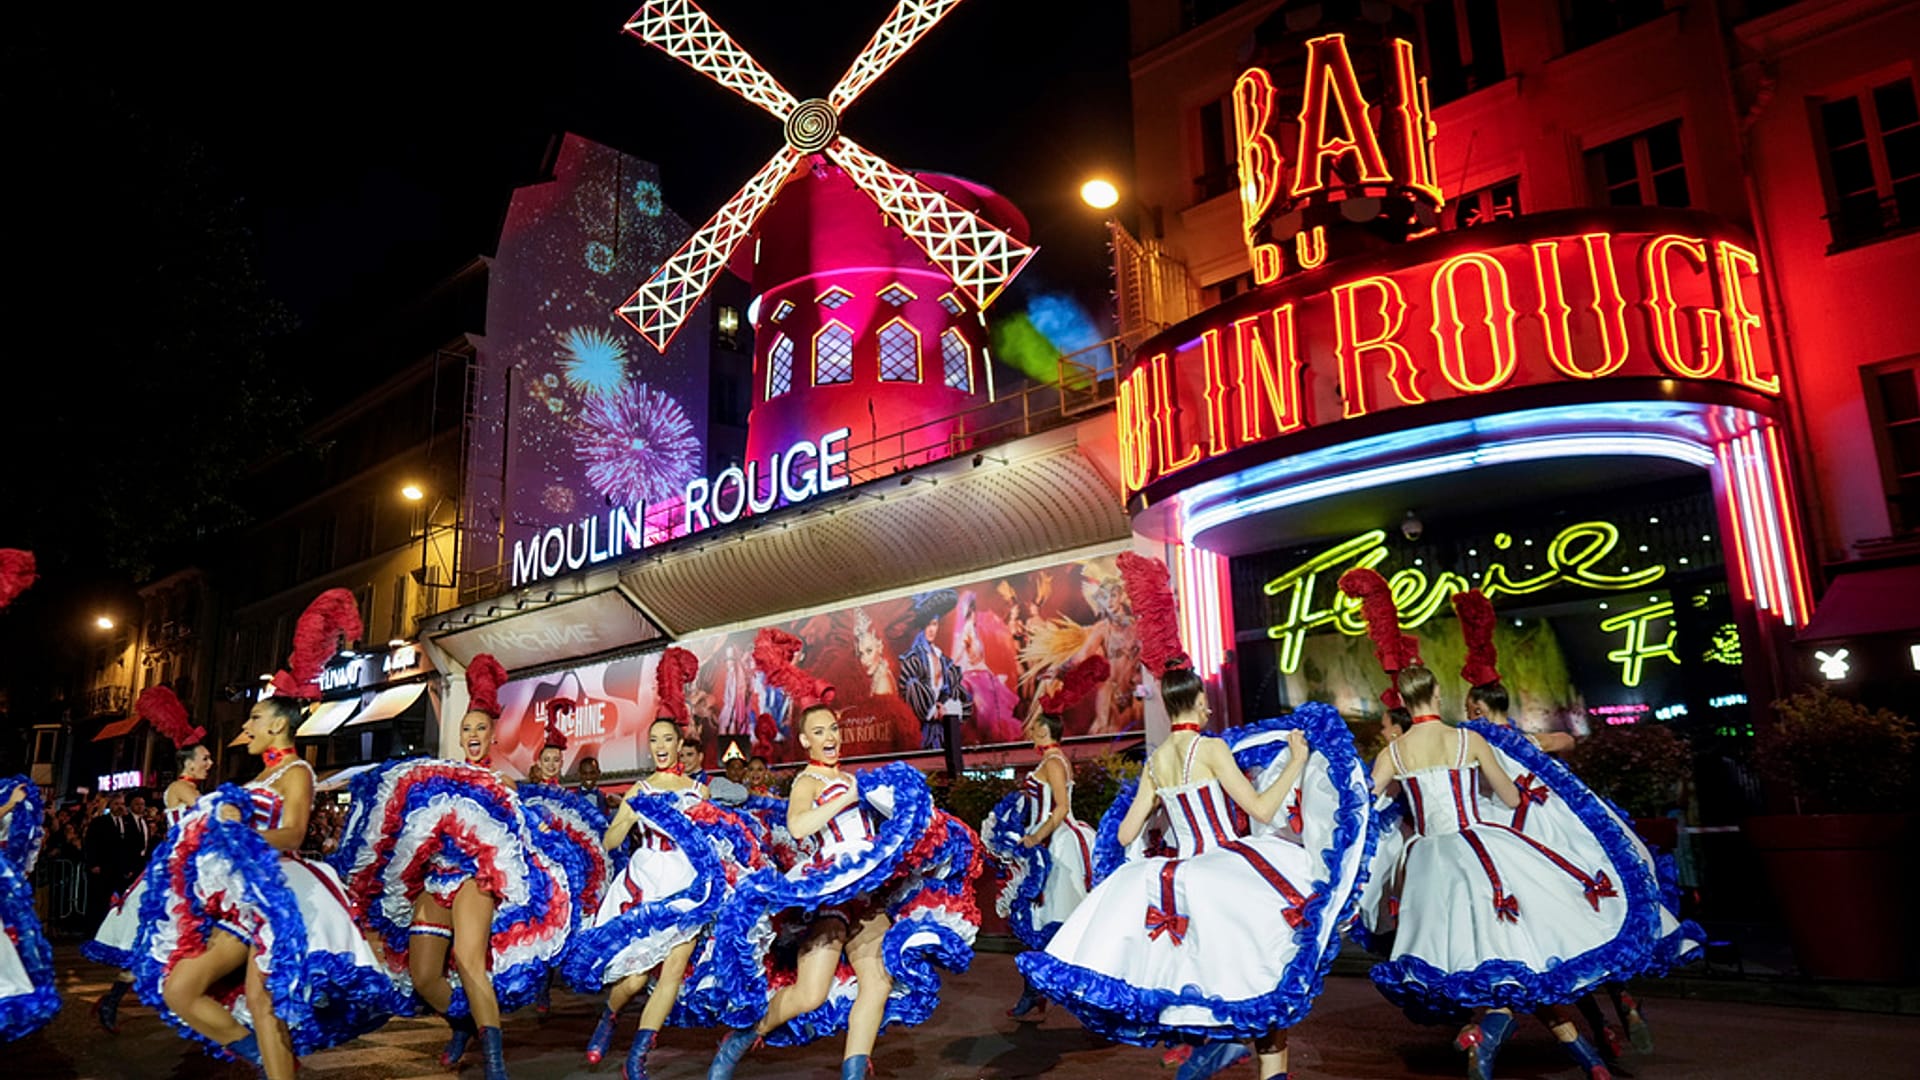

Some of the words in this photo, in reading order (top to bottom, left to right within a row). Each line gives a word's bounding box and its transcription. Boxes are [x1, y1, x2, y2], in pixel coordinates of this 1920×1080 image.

[1233, 33, 1444, 234] BAL
[1253, 225, 1327, 285] DU
[1117, 303, 1300, 500] ULIN
[1331, 233, 1780, 418] ROUGE
[512, 500, 645, 587] MOULIN
[684, 427, 850, 534] ROUGE
